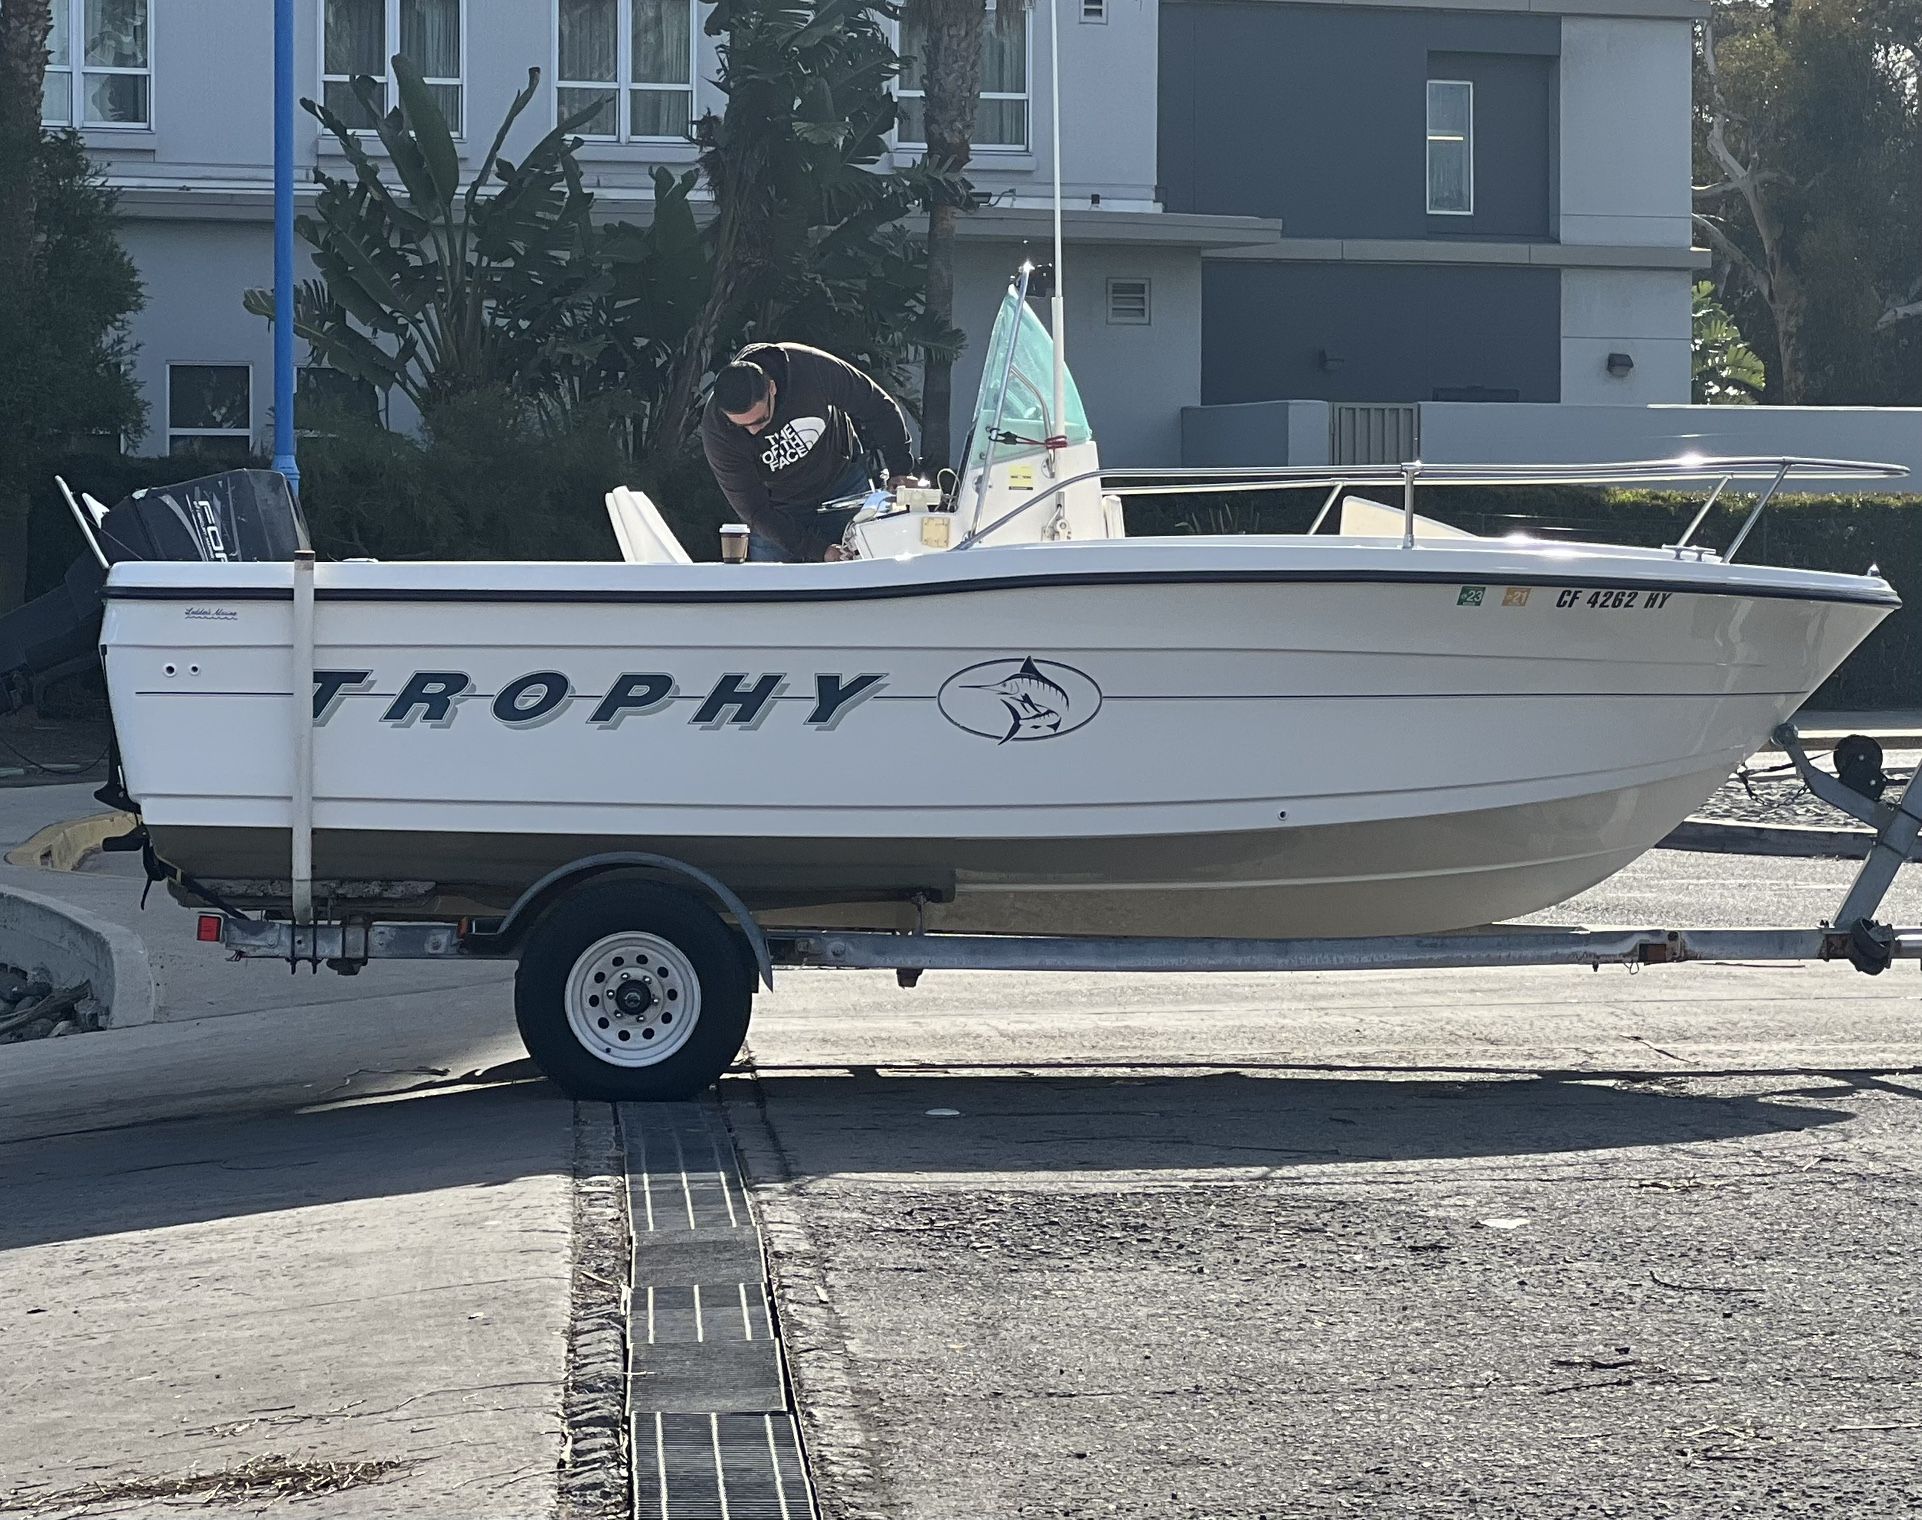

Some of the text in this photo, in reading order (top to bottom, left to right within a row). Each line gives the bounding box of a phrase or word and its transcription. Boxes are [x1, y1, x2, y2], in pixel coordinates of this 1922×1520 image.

[765, 423, 796, 446] THE
[770, 445, 809, 472] FACE
[1466, 590, 1483, 602] 23
[1513, 591, 1528, 603] 21
[1556, 589, 1672, 609] CF 4262 HY
[312, 669, 890, 731] TROPHY
